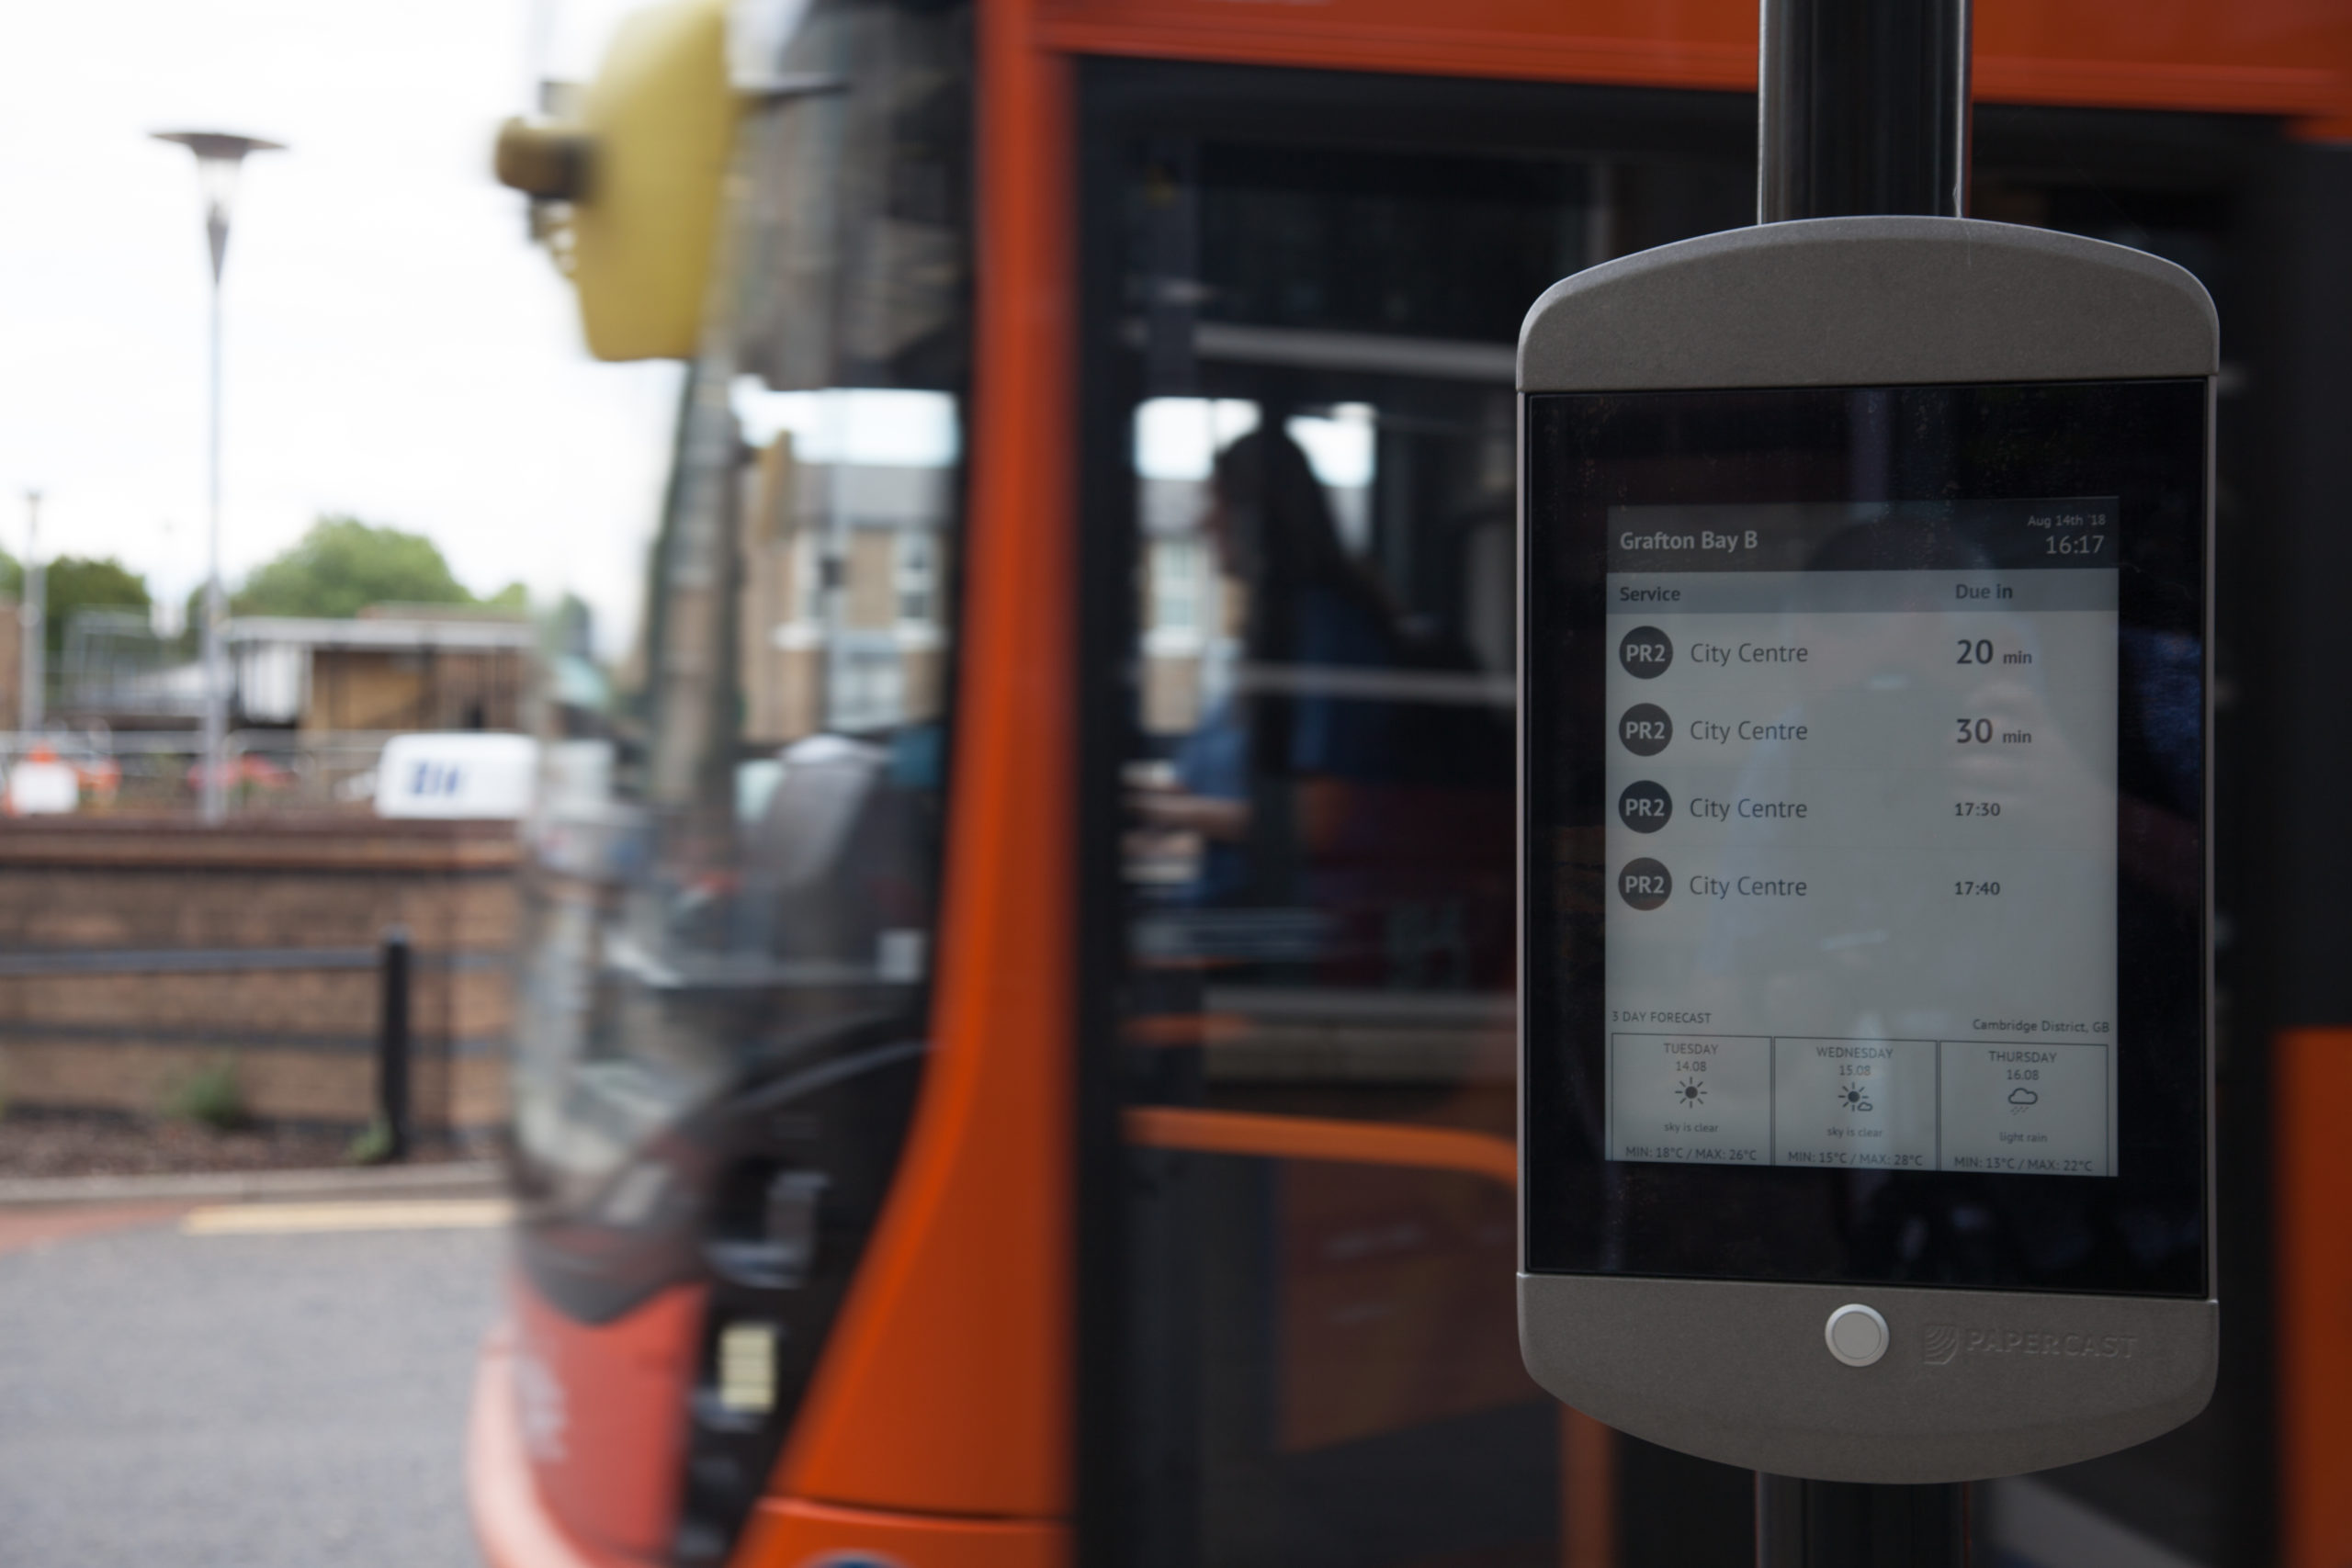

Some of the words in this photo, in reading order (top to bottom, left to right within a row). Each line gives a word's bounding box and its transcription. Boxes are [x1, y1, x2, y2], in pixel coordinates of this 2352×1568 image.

[2028, 514, 2052, 529] Aug
[2056, 513, 2084, 526] 14th
[1620, 530, 1694, 550] Grafton
[1702, 530, 1738, 553] Bay
[1745, 530, 1758, 548] B
[2046, 535, 2105, 555] 16:17
[1620, 585, 1680, 602] Service
[1955, 583, 1992, 600] Due
[1996, 583, 2013, 600] in
[1625, 645, 1666, 662] PR2
[1690, 644, 1731, 667] City
[1738, 644, 1808, 663] Centre
[1956, 638, 1994, 665] 20
[2003, 650, 2032, 664] min
[1625, 722, 1666, 739] PR2
[1690, 721, 1731, 744] City
[1738, 721, 1808, 740] Centre
[1956, 717, 1993, 744] 30
[2003, 728, 2032, 744] min
[1625, 799, 1666, 817] PR2
[1690, 798, 1731, 821] City
[1738, 798, 1808, 818] Centre
[1954, 802, 2001, 817] 17:30
[1625, 876, 1666, 894] PR2
[1690, 876, 1731, 899] City
[1738, 876, 1808, 897] Centre
[1954, 881, 2001, 897] 17:40
[1611, 1011, 1619, 1022] 3
[1623, 1011, 1646, 1023] DAY
[1650, 1012, 1713, 1024] FORECAST
[1973, 1019, 2038, 1033] Cambridge
[2041, 1021, 2089, 1033] District,
[2092, 1021, 2110, 1033] GB
[1664, 1043, 1719, 1055] TUESDAY
[1816, 1046, 1894, 1059] WEDNESDAY
[1988, 1051, 2058, 1063] THURSDAY
[1676, 1061, 1707, 1072] 14.08
[1838, 1065, 1871, 1077] 15.08
[2007, 1069, 2040, 1080] 16.08
[1664, 1122, 1680, 1134] sky
[1683, 1122, 1692, 1133] is
[1694, 1122, 1719, 1133] clear
[1826, 1127, 1845, 1138] sky
[1847, 1127, 1856, 1137] is
[1858, 1128, 1883, 1138] clear
[1999, 1132, 2024, 1145] light
[2027, 1133, 2048, 1144] rain
[1625, 1146, 1653, 1158] MIN:
[1696, 1148, 1726, 1160] MAX:
[1788, 1151, 1816, 1163] MIN:
[1860, 1154, 1891, 1166] MAX:
[1954, 1156, 1983, 1168] MIN:
[2028, 1159, 2059, 1171] MAX:
[1965, 1328, 2138, 1359] PAPERCAST
